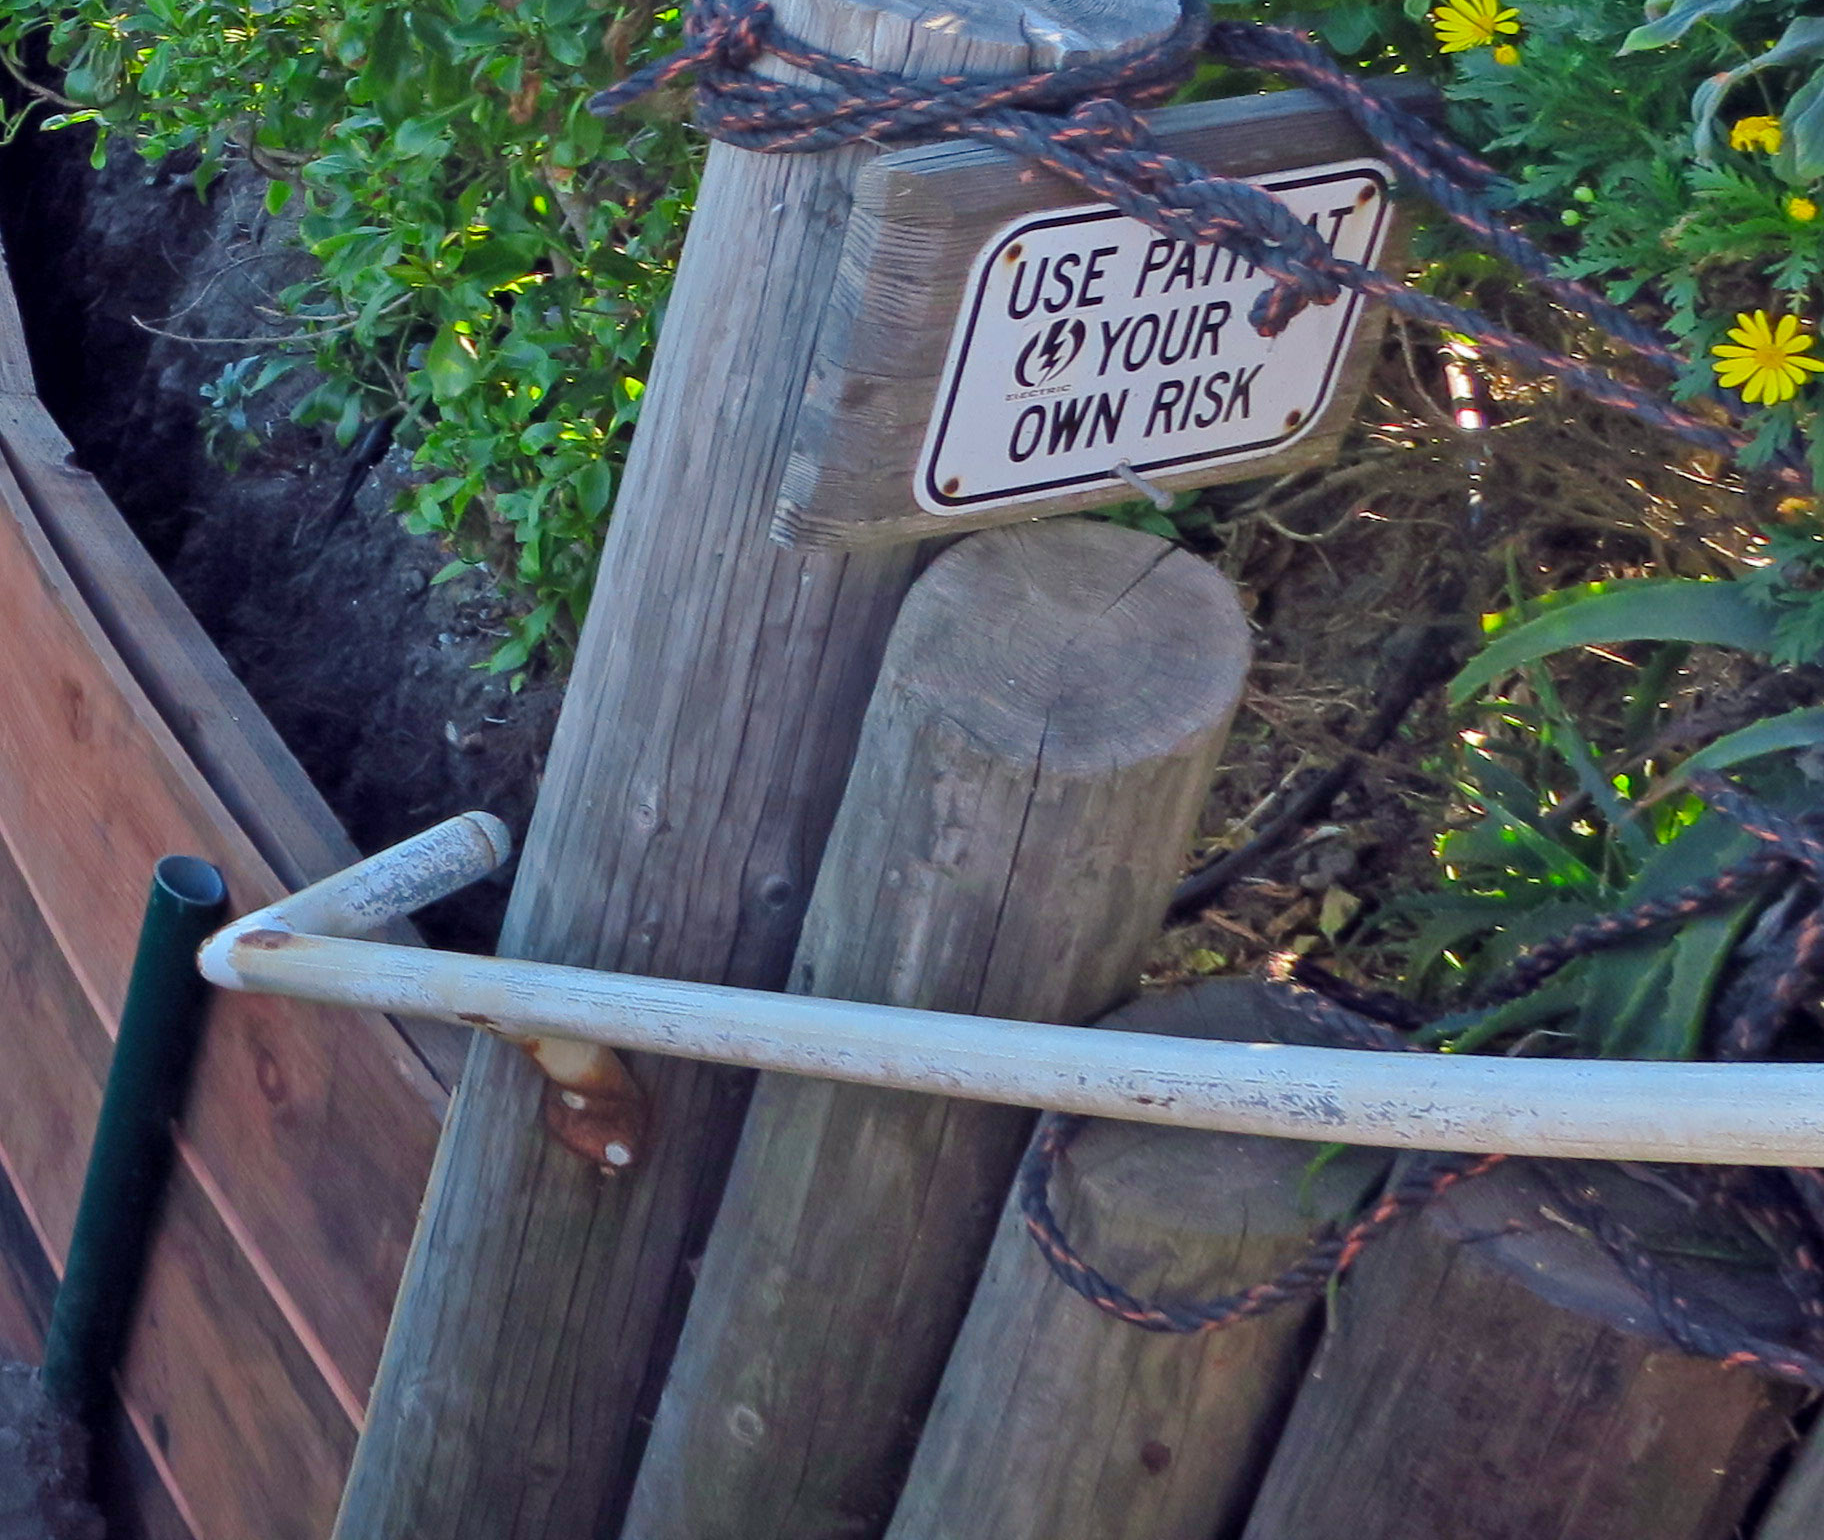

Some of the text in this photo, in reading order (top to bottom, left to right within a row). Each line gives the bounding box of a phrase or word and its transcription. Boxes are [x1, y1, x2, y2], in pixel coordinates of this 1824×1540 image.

[1008, 246, 1119, 319] USE
[1097, 300, 1232, 376] YOUR
[1008, 364, 1265, 463] OWN RISK
